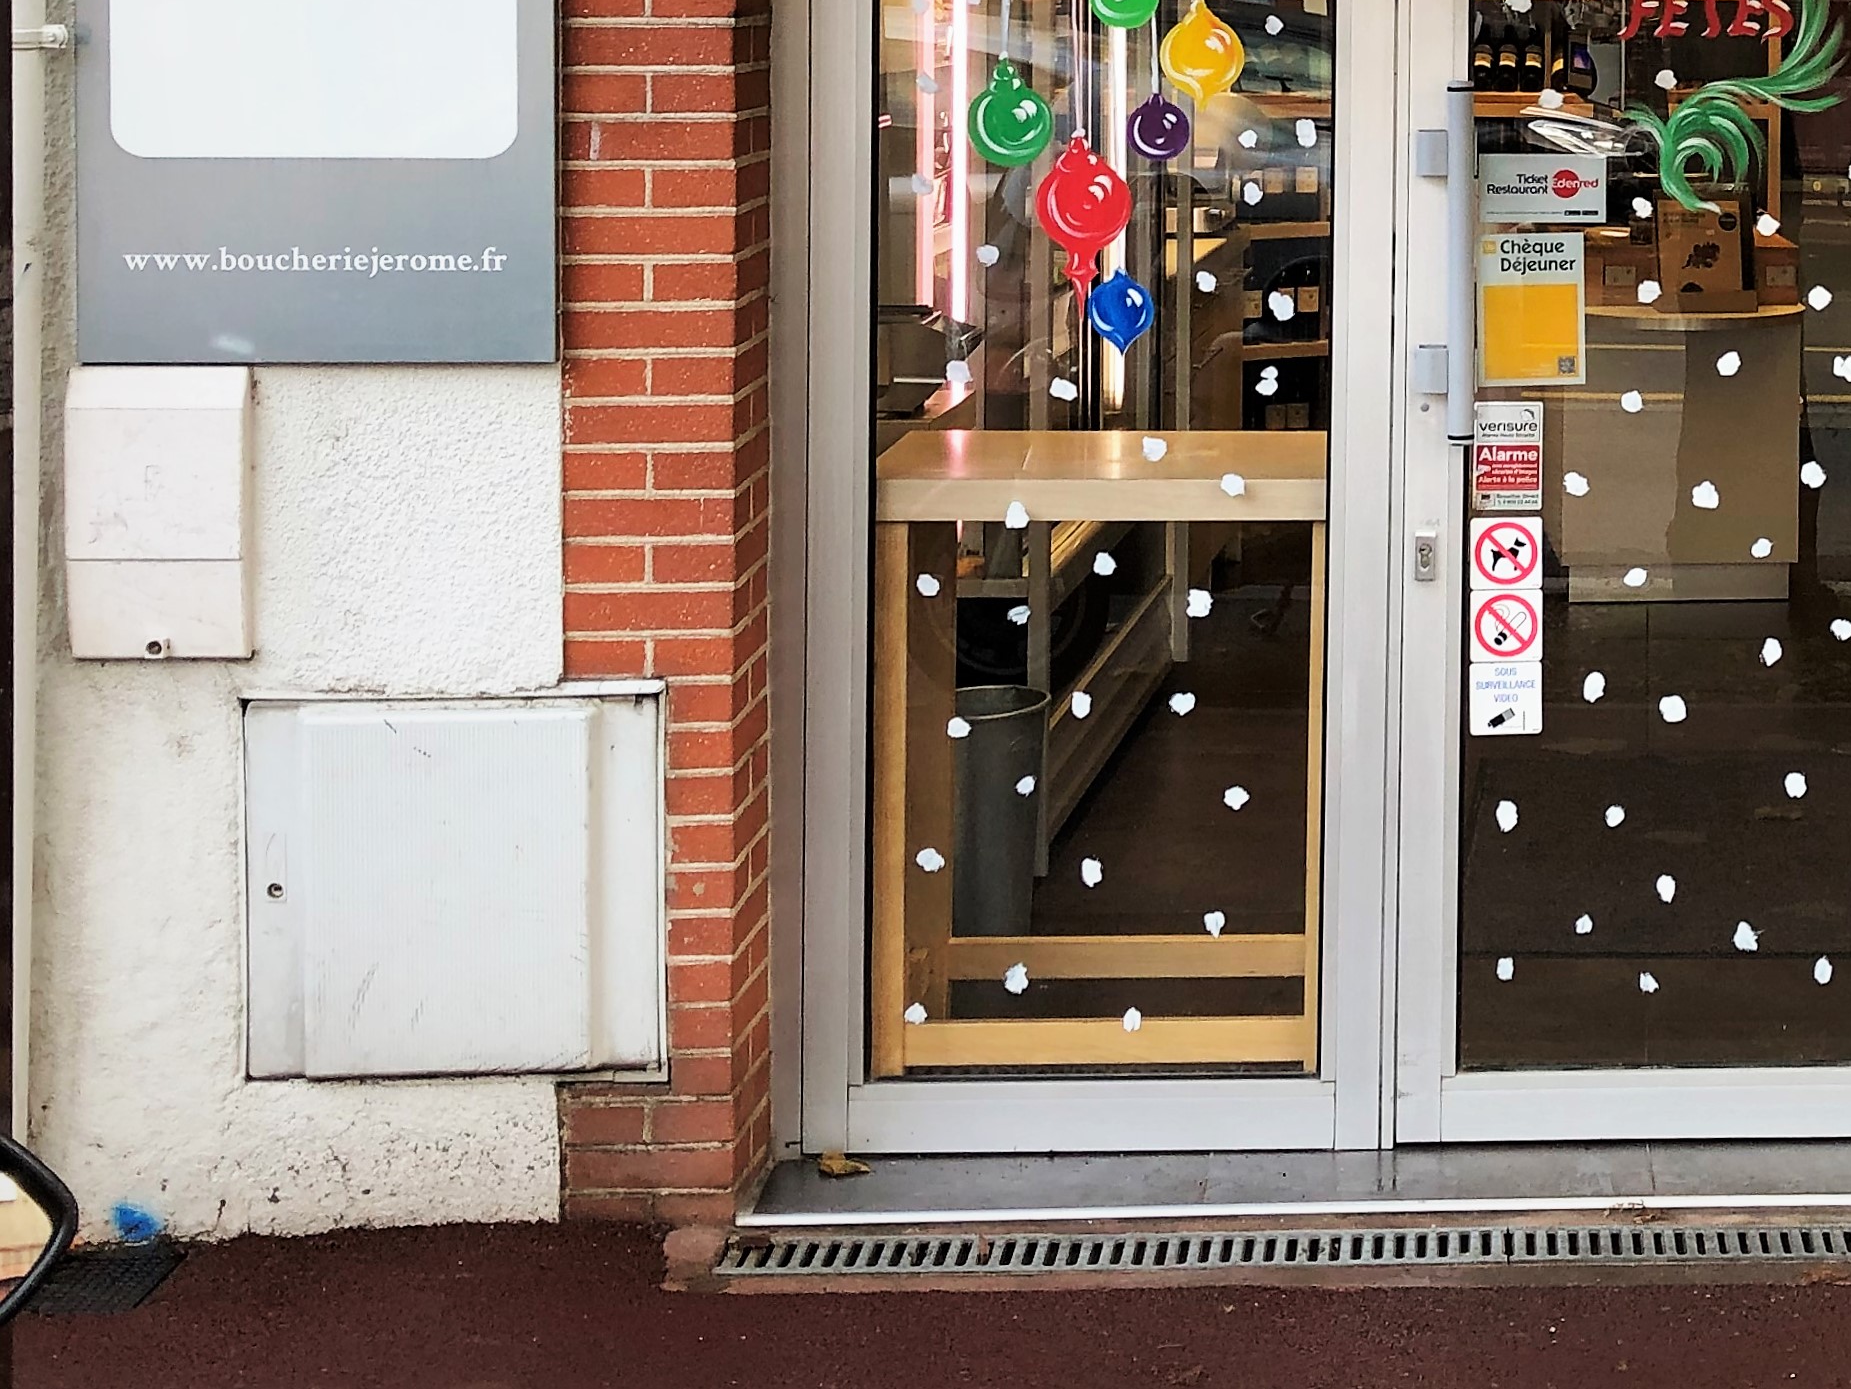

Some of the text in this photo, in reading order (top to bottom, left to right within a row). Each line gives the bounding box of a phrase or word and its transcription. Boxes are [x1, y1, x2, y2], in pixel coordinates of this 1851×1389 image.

[1516, 173, 1549, 185] Ticket
[1551, 177, 1599, 189] Edenred
[1486, 183, 1549, 195] Restaurant
[1500, 238, 1565, 257] Chèque
[123, 246, 509, 279] www.boucheriejerome.fr
[1500, 256, 1577, 276] Déjeuner
[1479, 421, 1538, 432] verisure
[1479, 446, 1538, 461] Alarme
[1494, 667, 1517, 677] SOUS
